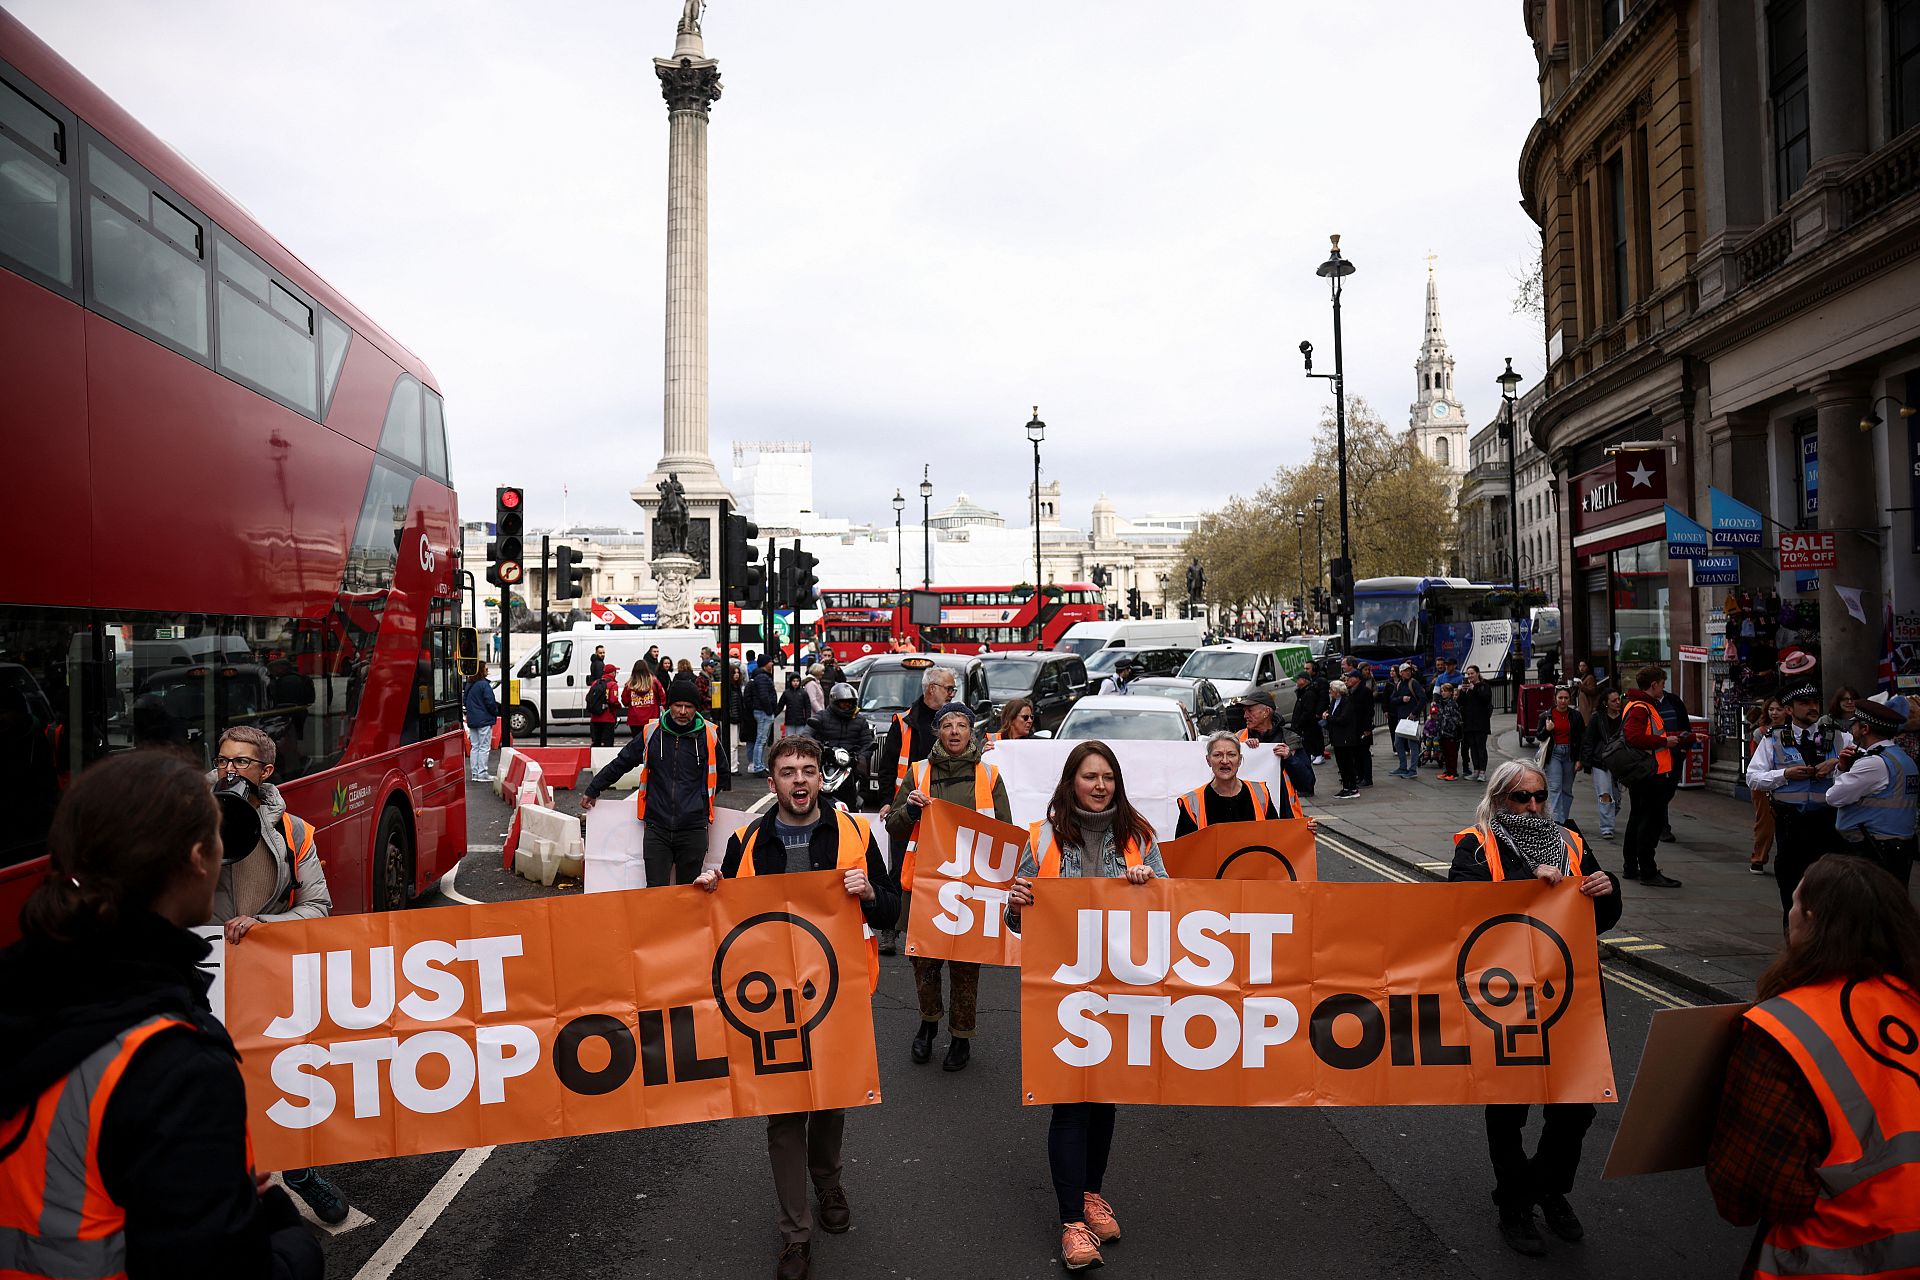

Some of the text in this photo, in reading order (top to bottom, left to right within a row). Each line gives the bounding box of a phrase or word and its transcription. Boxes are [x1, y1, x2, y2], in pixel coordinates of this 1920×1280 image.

[1590, 484, 1606, 512] PRET
[1607, 482, 1613, 507] A
[1718, 518, 1758, 528] MONEY
[1672, 532, 1704, 542] MONEY
[1714, 532, 1761, 543] CHANGE
[1781, 536, 1834, 551] SALE
[419, 533, 435, 573] Go
[1669, 545, 1707, 556] CHANGE
[1781, 552, 1835, 563] 70% OFF
[1697, 558, 1733, 568] MONEY
[1695, 573, 1738, 583] CHANGE
[1481, 622, 1508, 634] SIGHTSEEING
[1481, 632, 1508, 646] EVERYWHERE
[1282, 649, 1308, 675] zipcar
[936, 825, 1019, 883] JU
[931, 881, 1010, 938] ST
[1051, 908, 1293, 987] JUST
[263, 934, 523, 1039] JUST
[1052, 991, 1471, 1070] STOP OIL
[265, 1005, 730, 1129] STOP OIL
